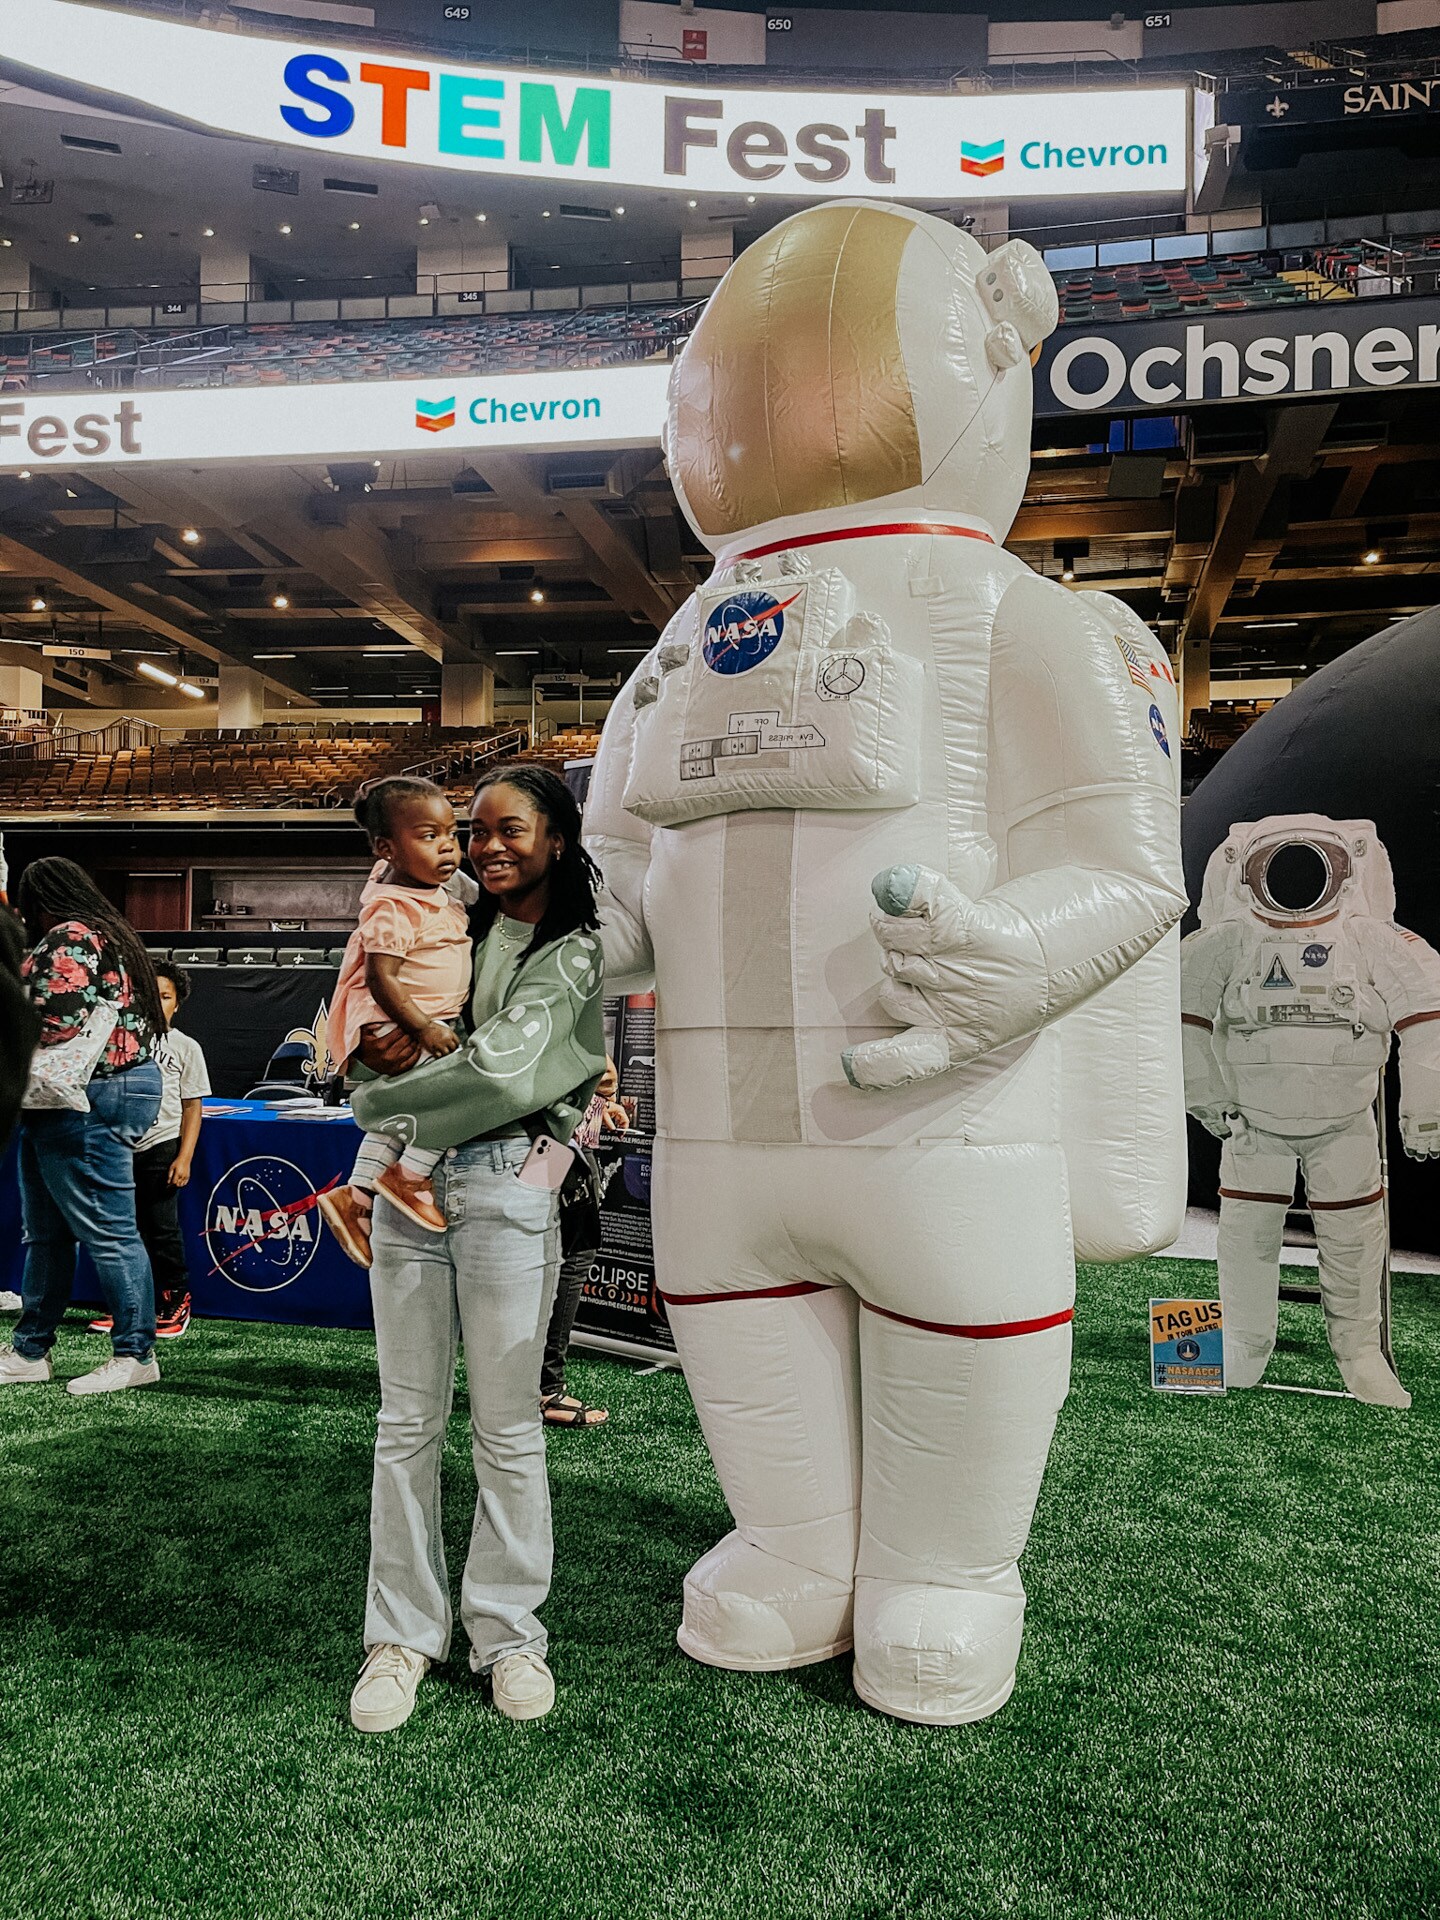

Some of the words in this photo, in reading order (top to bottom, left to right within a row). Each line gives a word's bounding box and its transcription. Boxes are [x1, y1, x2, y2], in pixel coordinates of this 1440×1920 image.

[445, 7, 469, 19] 649
[767, 19, 791, 30] 650
[1145, 15, 1170, 27] 651
[280, 54, 611, 169] STEM
[663, 96, 897, 185] Fest
[1020, 140, 1168, 170] Chevron
[167, 304, 181, 313] 344
[462, 292, 477, 301] 345
[1050, 325, 1440, 410] Ochsner
[468, 396, 602, 426] Chevron
[0, 400, 143, 457] Fest
[707, 618, 778, 645] NASA
[68, 648, 85, 656] 150
[1304, 952, 1327, 960] NASA
[214, 1205, 313, 1242] NASA
[588, 1264, 649, 1292] CLIPSE
[587, 1296, 608, 1307] THROUGH
[1153, 1310, 1192, 1333] TAG
[1194, 1303, 1222, 1322] US
